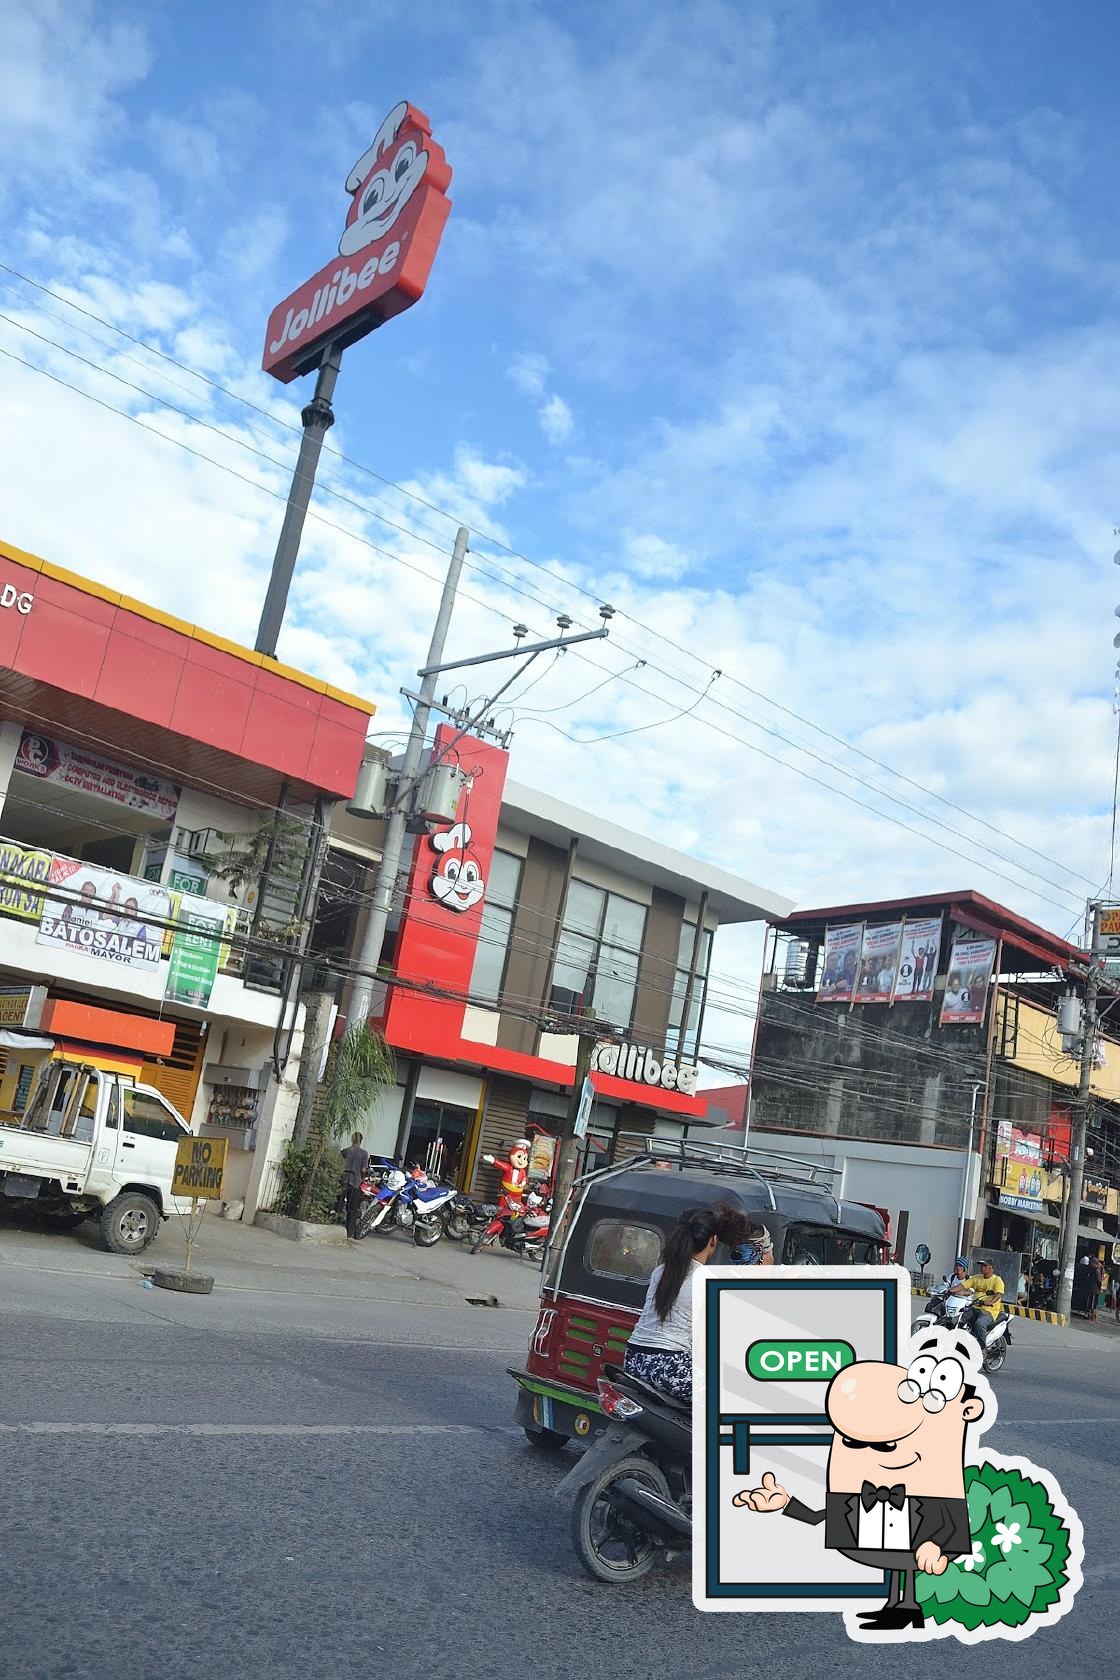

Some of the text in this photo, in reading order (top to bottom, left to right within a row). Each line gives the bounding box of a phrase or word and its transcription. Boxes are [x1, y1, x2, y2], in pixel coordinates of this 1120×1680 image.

[270, 240, 402, 355] Jollibee
[15, 756, 47, 775] WORKS
[173, 872, 200, 894] FOR
[39, 916, 162, 964] BATOSALEM
[90, 947, 132, 965] MAYOR
[594, 1042, 695, 1093] ollibee
[190, 1141, 213, 1166] NO
[174, 1163, 224, 1189] PARKING
